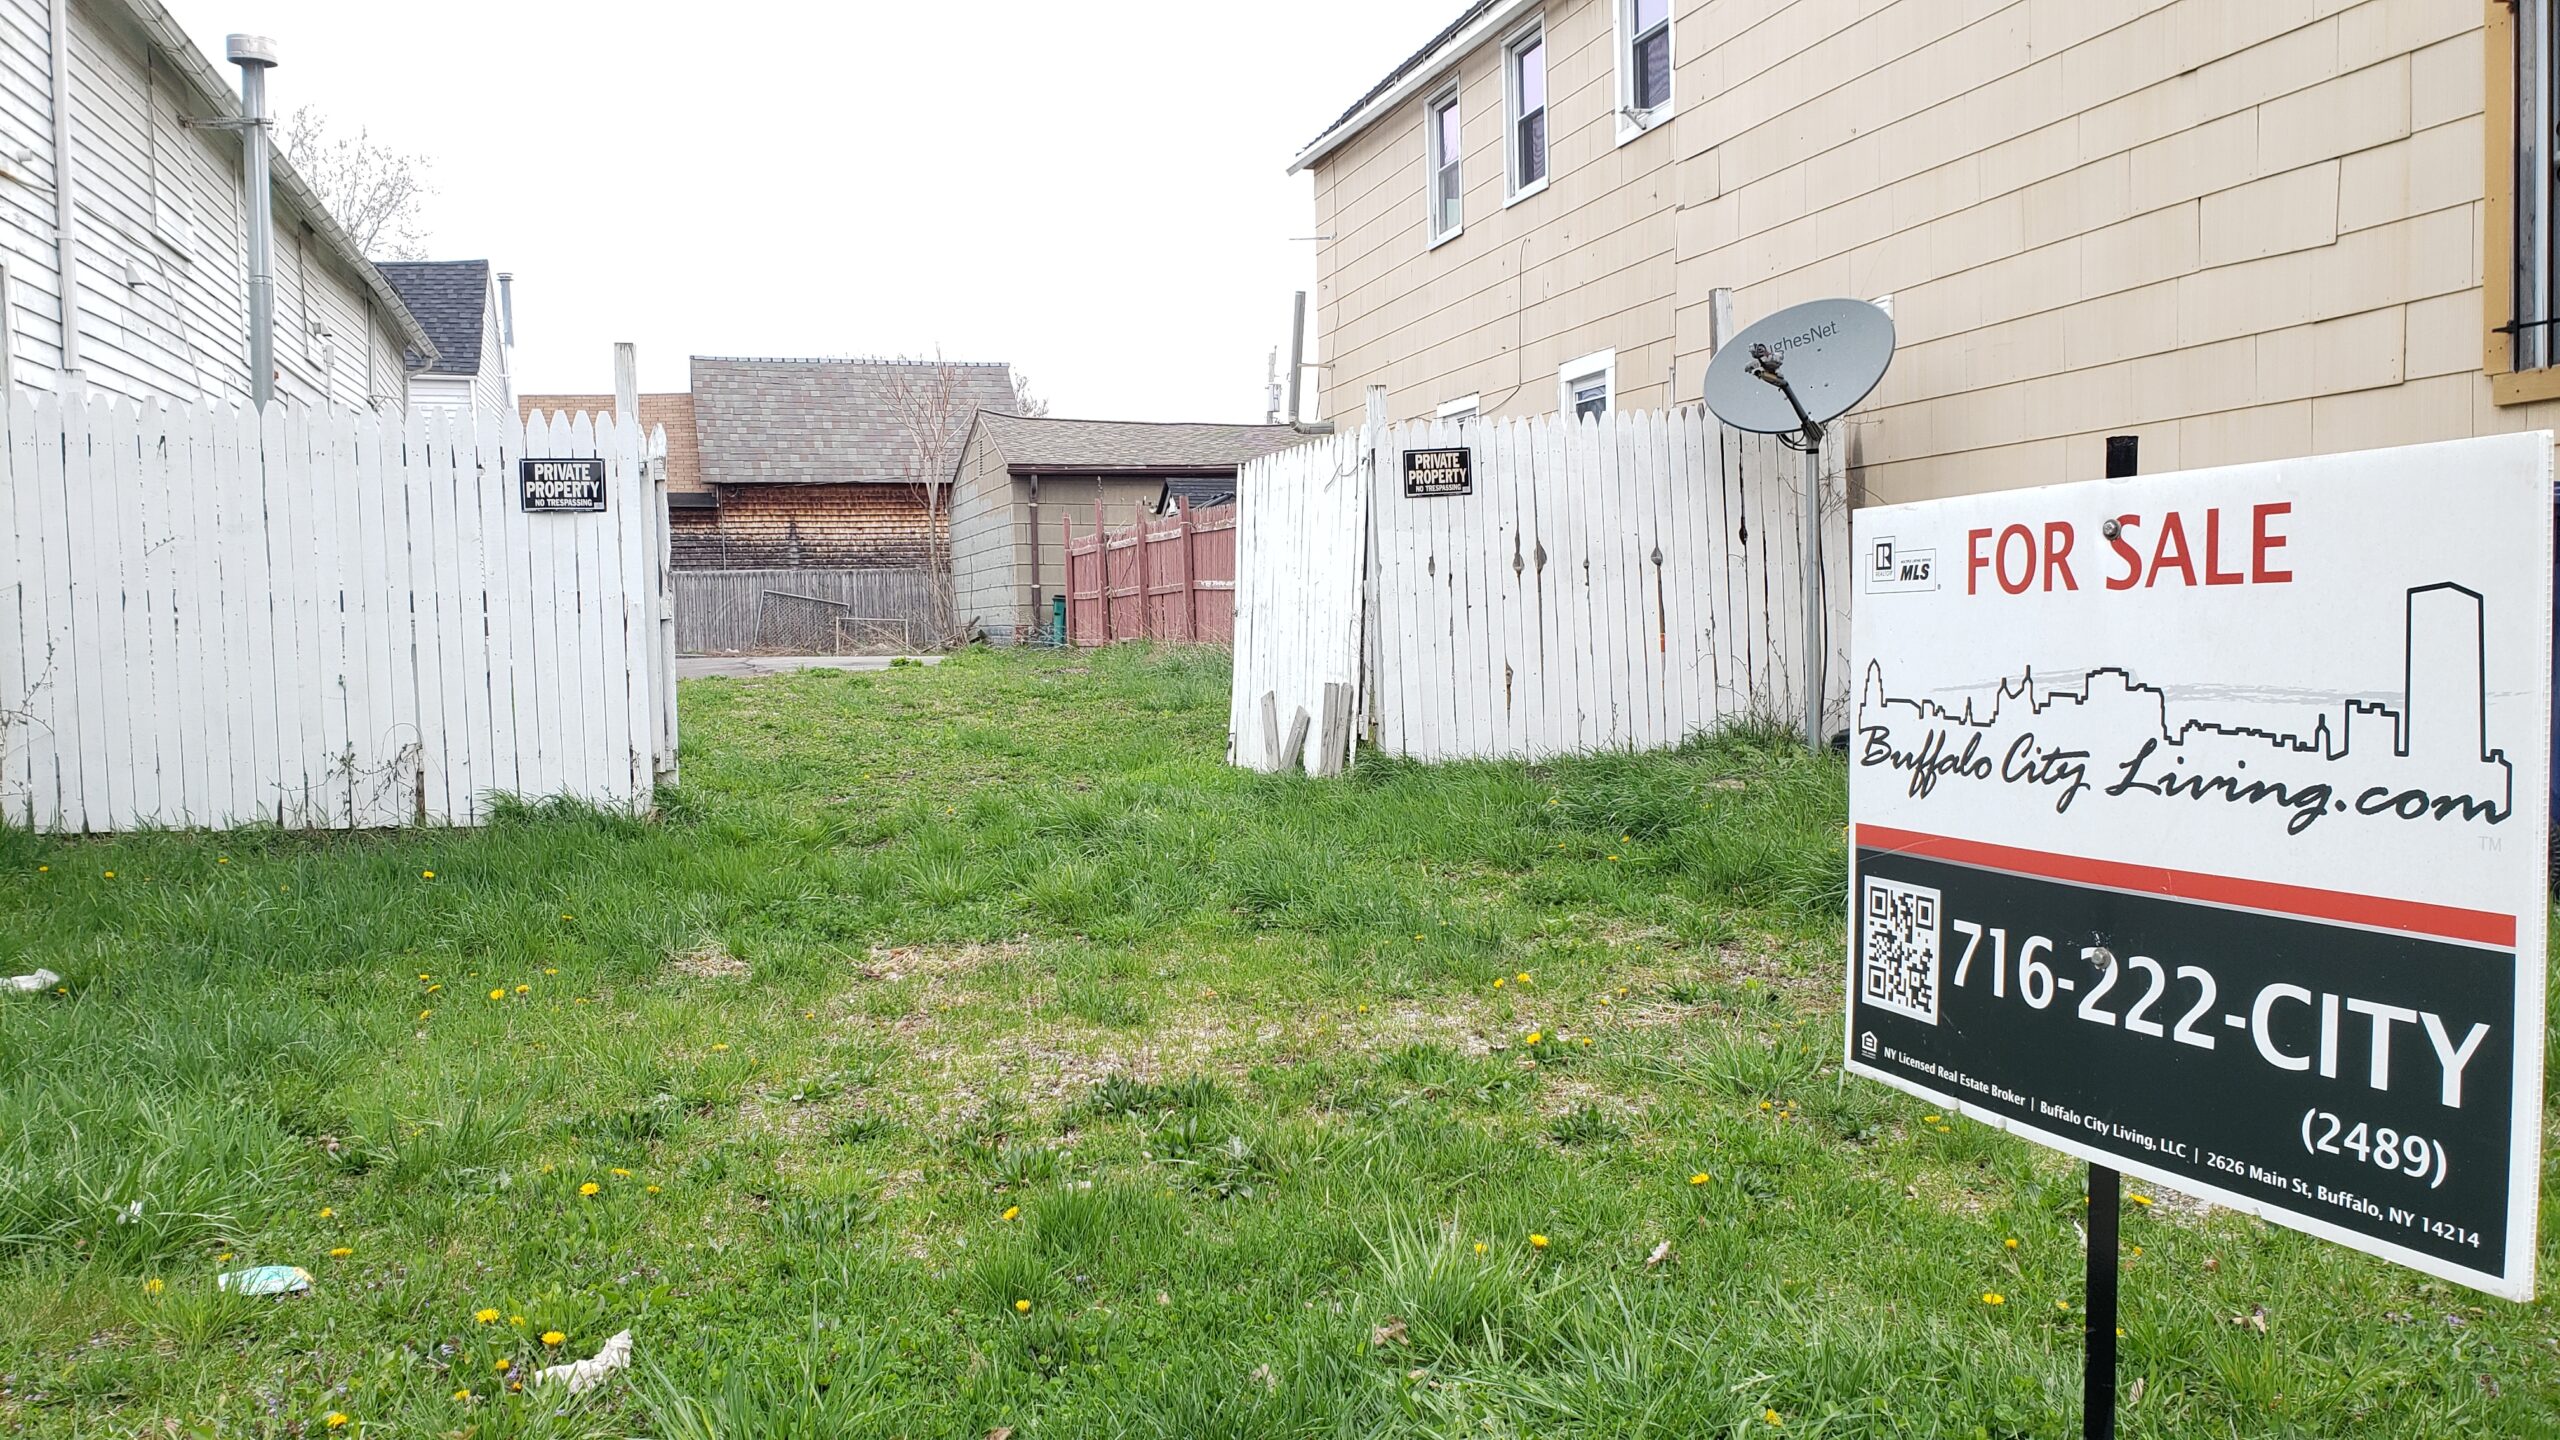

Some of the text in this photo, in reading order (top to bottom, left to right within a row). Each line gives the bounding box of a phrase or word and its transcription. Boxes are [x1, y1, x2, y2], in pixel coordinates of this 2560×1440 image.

[1768, 321, 1837, 356] ghesNet
[1415, 452, 1460, 469] PRIVATE
[534, 463, 591, 481] PRIVATE
[1408, 468, 1467, 485] PROPERTY
[526, 481, 600, 498] PROPERTY
[1425, 484, 1461, 492] TRESPASSING
[535, 498, 592, 507] NO TRESPASSING
[1968, 502, 2293, 595] FOR SALE
[1900, 563, 1930, 581] MLS
[1860, 725, 2507, 835] Buffalo City Living.com
[2478, 836, 2502, 852] TM
[1952, 918, 2491, 1108] 716-222-CITY
[1884, 1047, 1897, 1060] NY
[1898, 1050, 1936, 1075] Licensed
[1937, 1066, 1958, 1083] Real
[1960, 1073, 1989, 1094] Estate
[1992, 1084, 2026, 1106] Broker
[2040, 1100, 2081, 1125] Buffalo
[2084, 1116, 2109, 1136] City
[2113, 1123, 2157, 1151] Living,
[2160, 1138, 2186, 1158] LLC
[2206, 1152, 2245, 1176] 2626
[2250, 1165, 2287, 1189] Main
[2292, 1178, 2312, 1199] St,
[2318, 1185, 2383, 1221] Buffalo,
[2389, 1207, 2415, 1228] NY
[2422, 1217, 2480, 1248] 14214
[2302, 1108, 2447, 1189] (2489)
